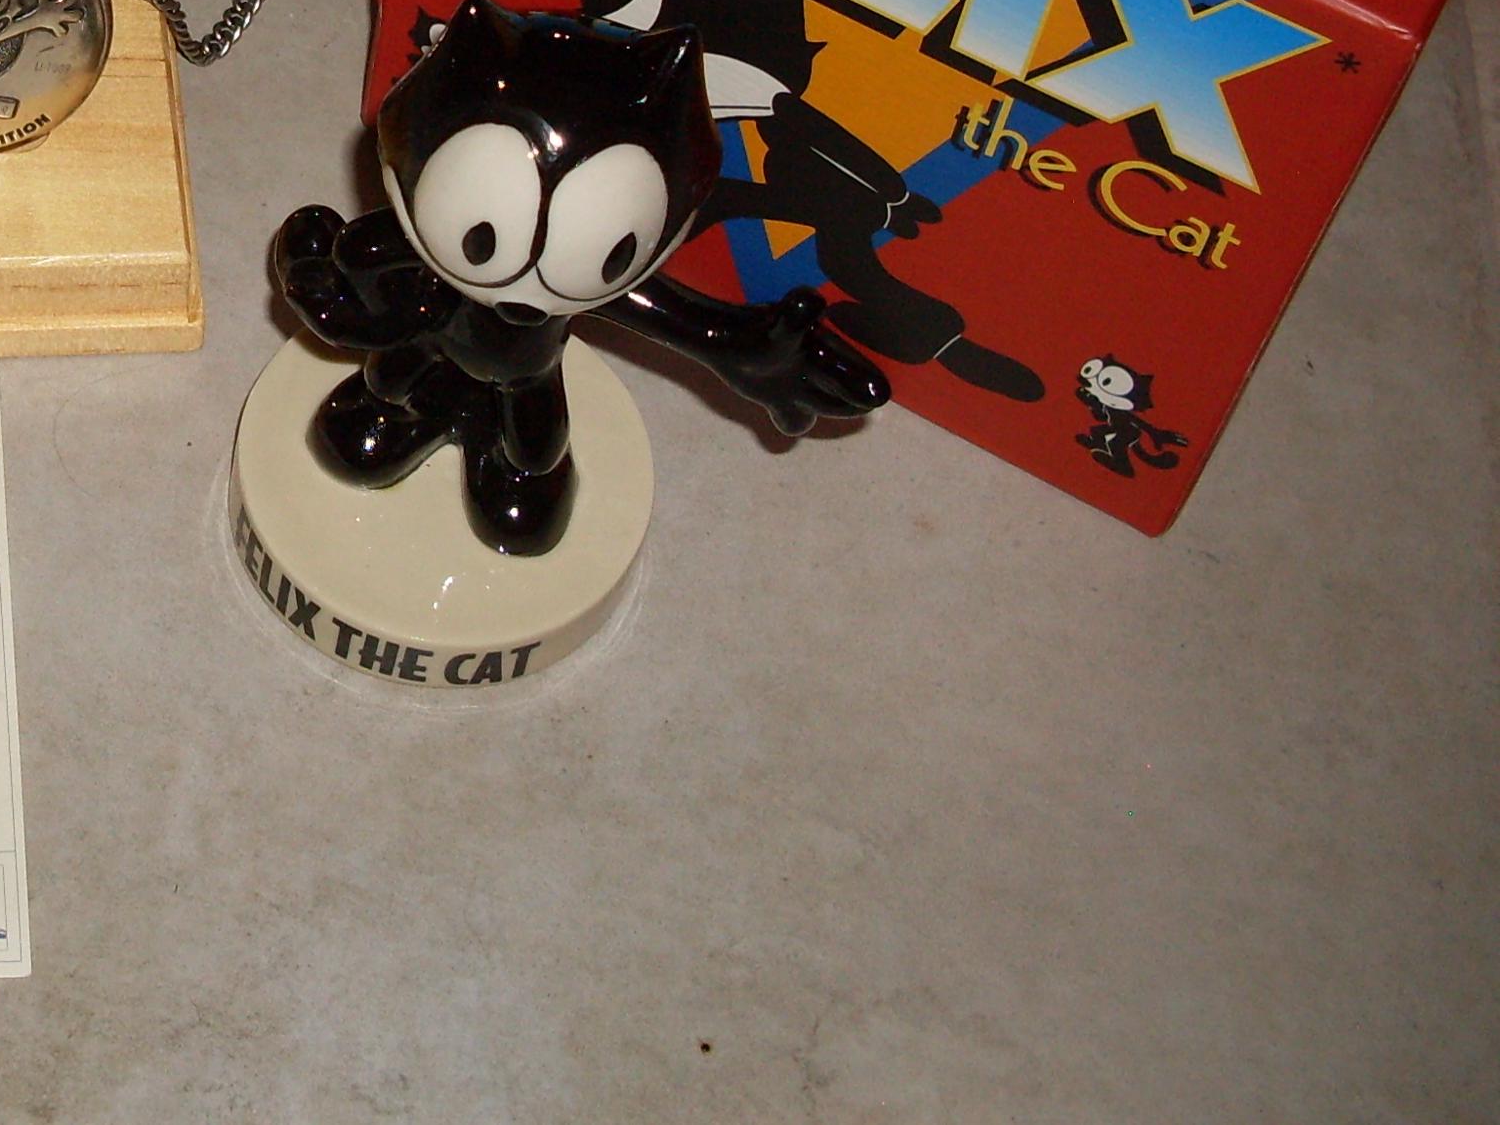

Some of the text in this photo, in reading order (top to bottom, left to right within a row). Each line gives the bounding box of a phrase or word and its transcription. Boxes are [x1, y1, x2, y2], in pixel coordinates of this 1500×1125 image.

[955, 96, 1241, 270] the Cat
[234, 503, 542, 686] FELIX THE CAT
